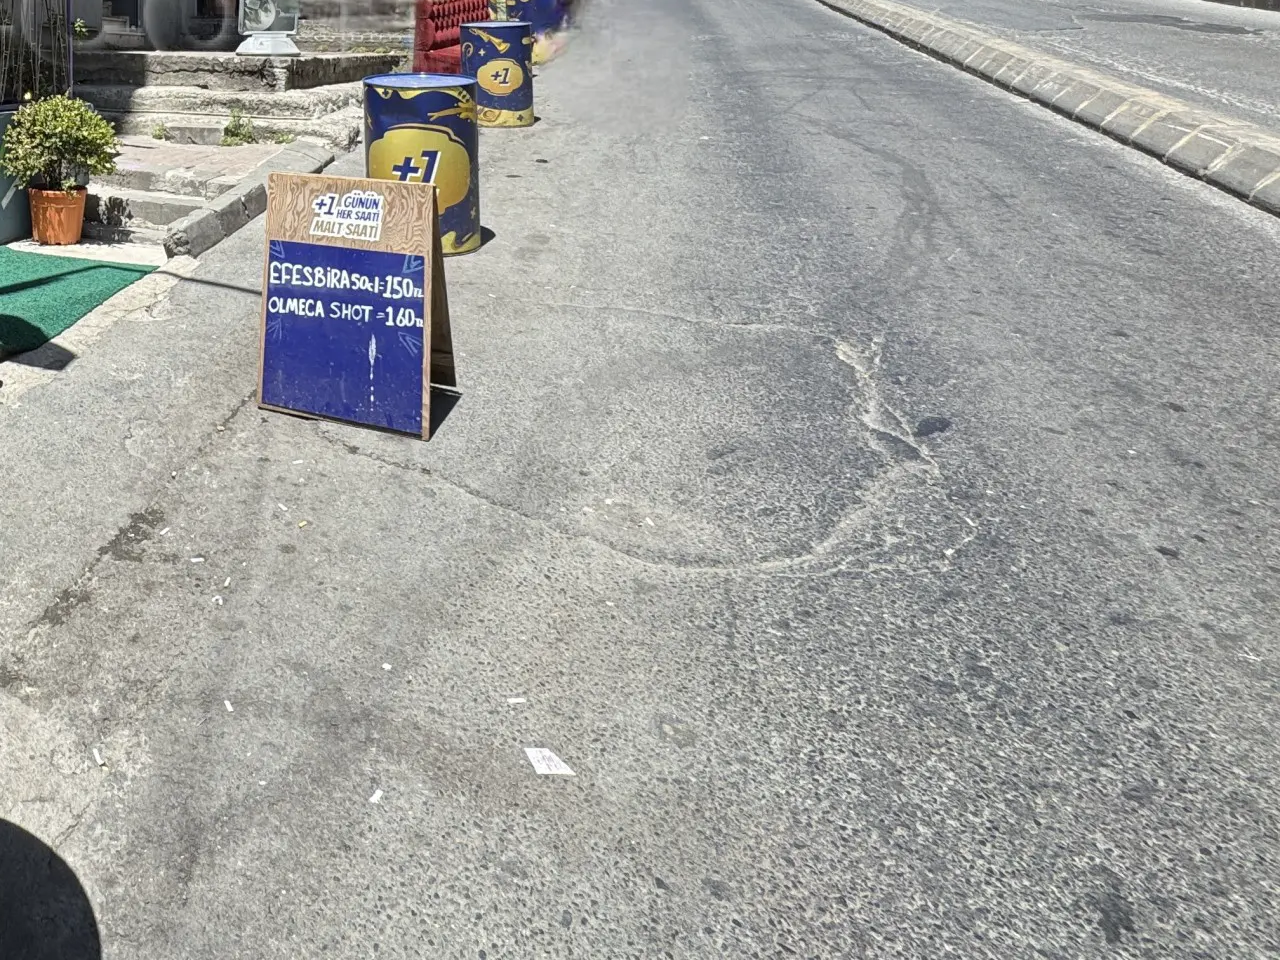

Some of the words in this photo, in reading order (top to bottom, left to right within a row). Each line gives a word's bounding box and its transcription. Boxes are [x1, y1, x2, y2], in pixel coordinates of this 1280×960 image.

[491, 67, 510, 85] +1
[315, 196, 336, 216] +1
[343, 192, 381, 209] GÜNÜN
[336, 209, 352, 219] HER
[355, 209, 380, 222] SAATİ
[313, 219, 342, 235] MALT
[345, 222, 380, 239] SAATİ
[268, 296, 325, 318] OLMECA
[330, 302, 373, 322] SHOT
